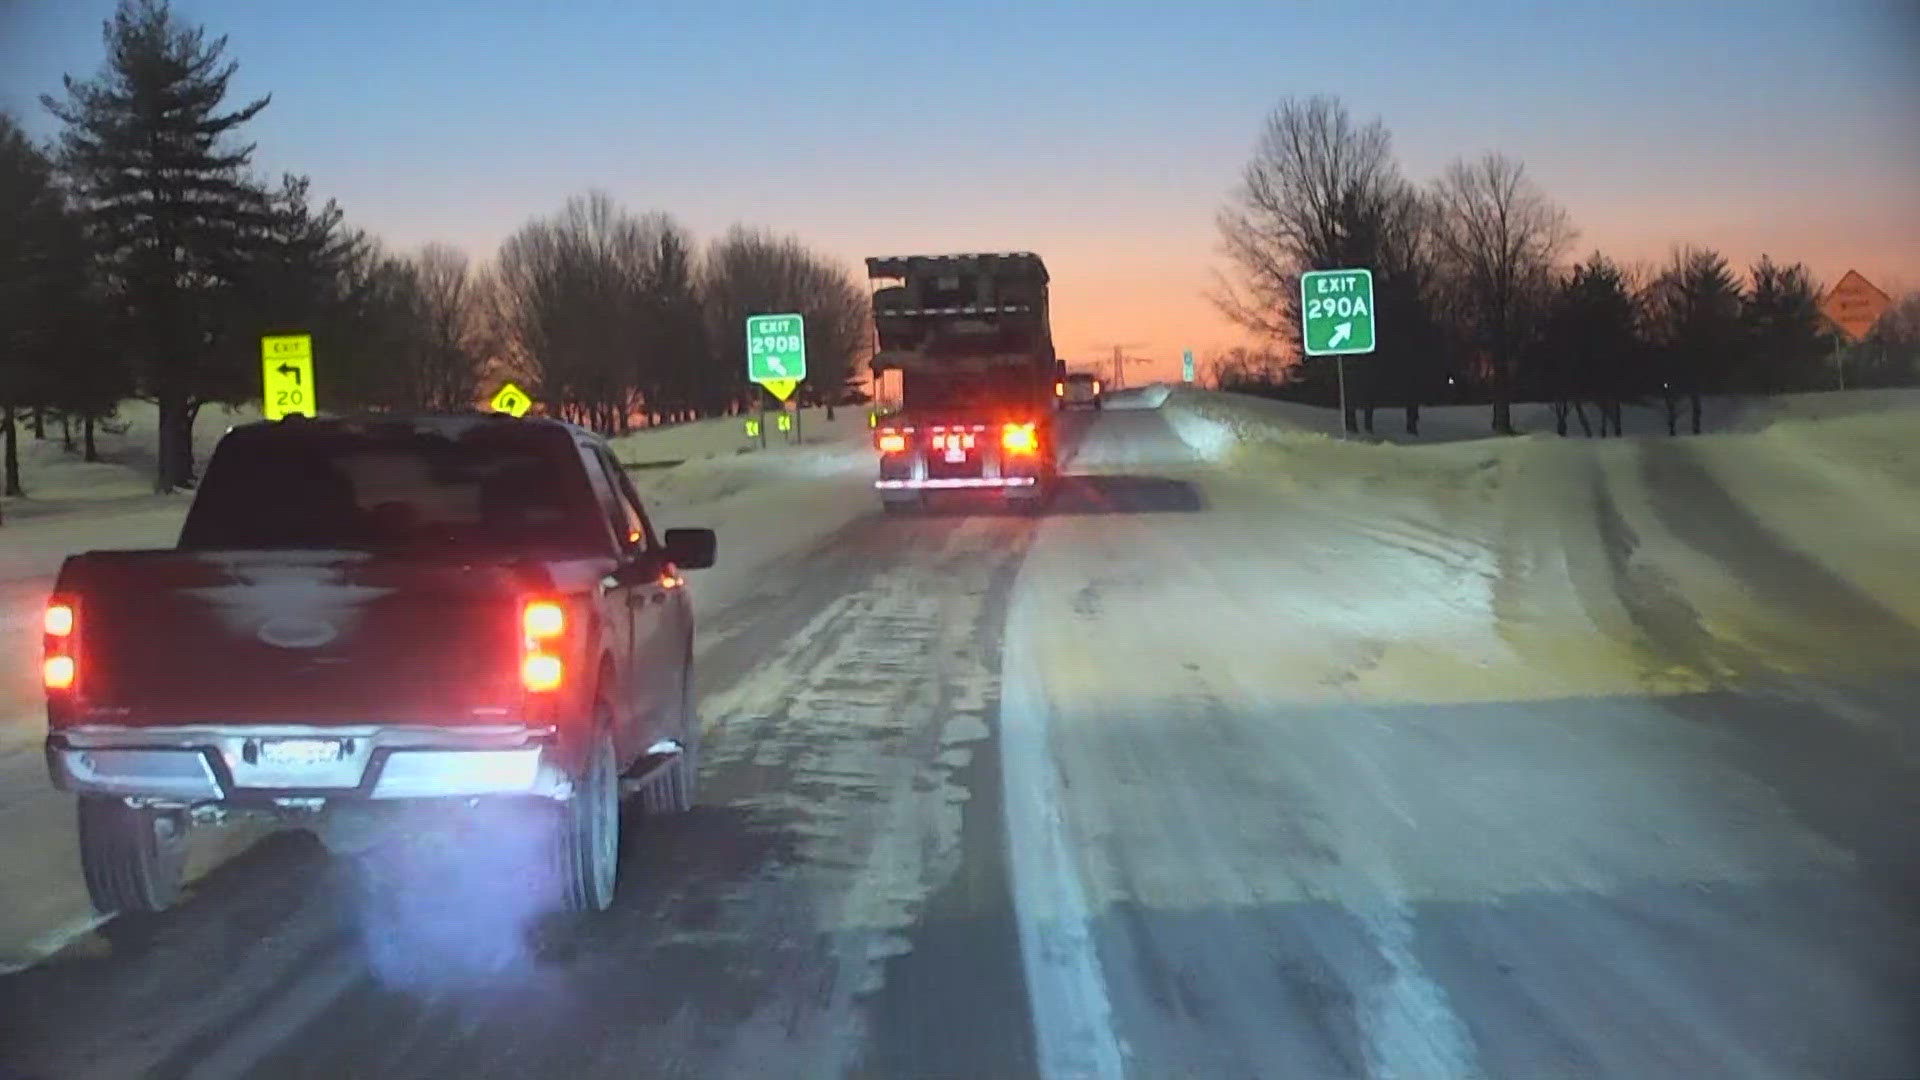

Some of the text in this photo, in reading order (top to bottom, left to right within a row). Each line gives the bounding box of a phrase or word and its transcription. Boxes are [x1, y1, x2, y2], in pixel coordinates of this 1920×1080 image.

[1317, 276, 1357, 294] EXIT
[1308, 296, 1368, 320] 290A
[759, 320, 791, 334] EXIT
[752, 335, 800, 354] 290B
[276, 389, 303, 406] 20
